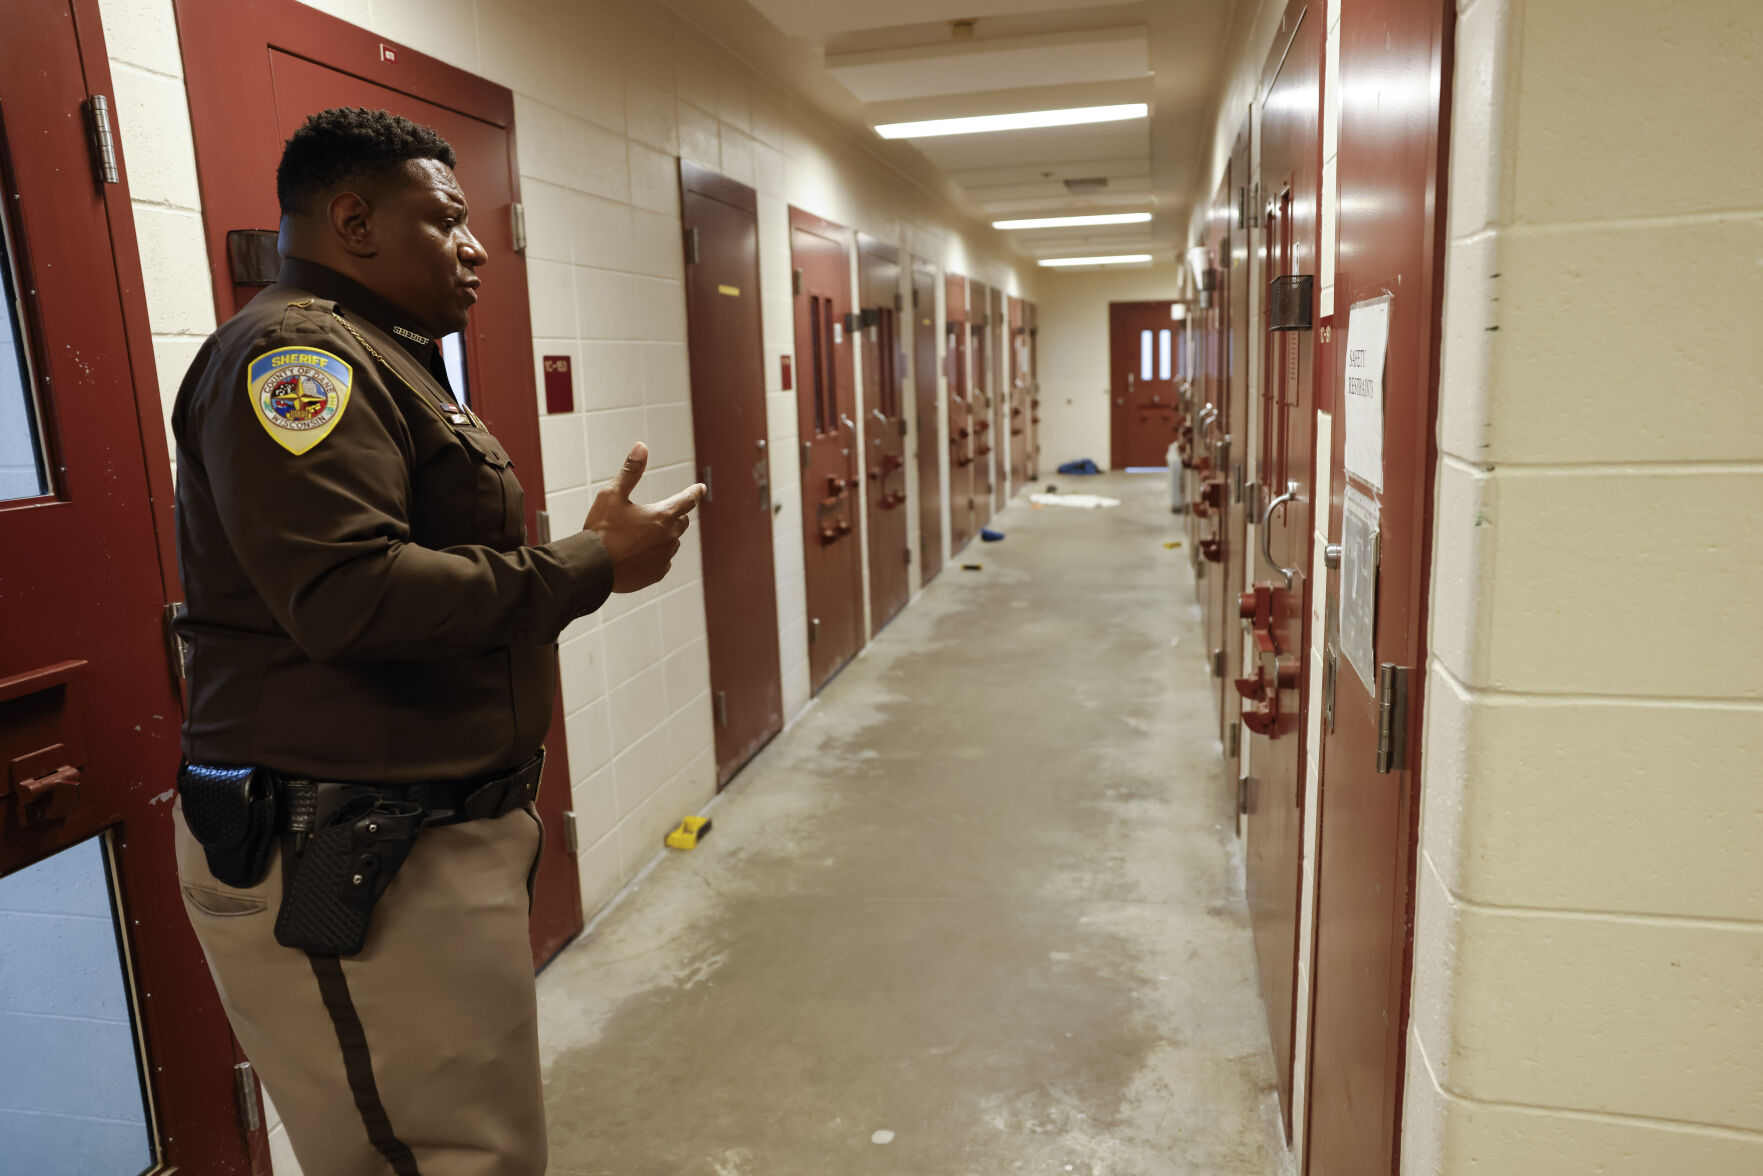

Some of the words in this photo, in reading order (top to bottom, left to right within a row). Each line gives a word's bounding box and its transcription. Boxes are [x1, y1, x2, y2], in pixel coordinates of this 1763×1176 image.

[271, 353, 329, 368] SHERIFF
[1349, 349, 1366, 368] SAFETY
[263, 367, 295, 394] COUNTY
[297, 367, 312, 376] OF
[312, 372, 337, 394] DANE
[271, 414, 327, 431] WISCONSIN
